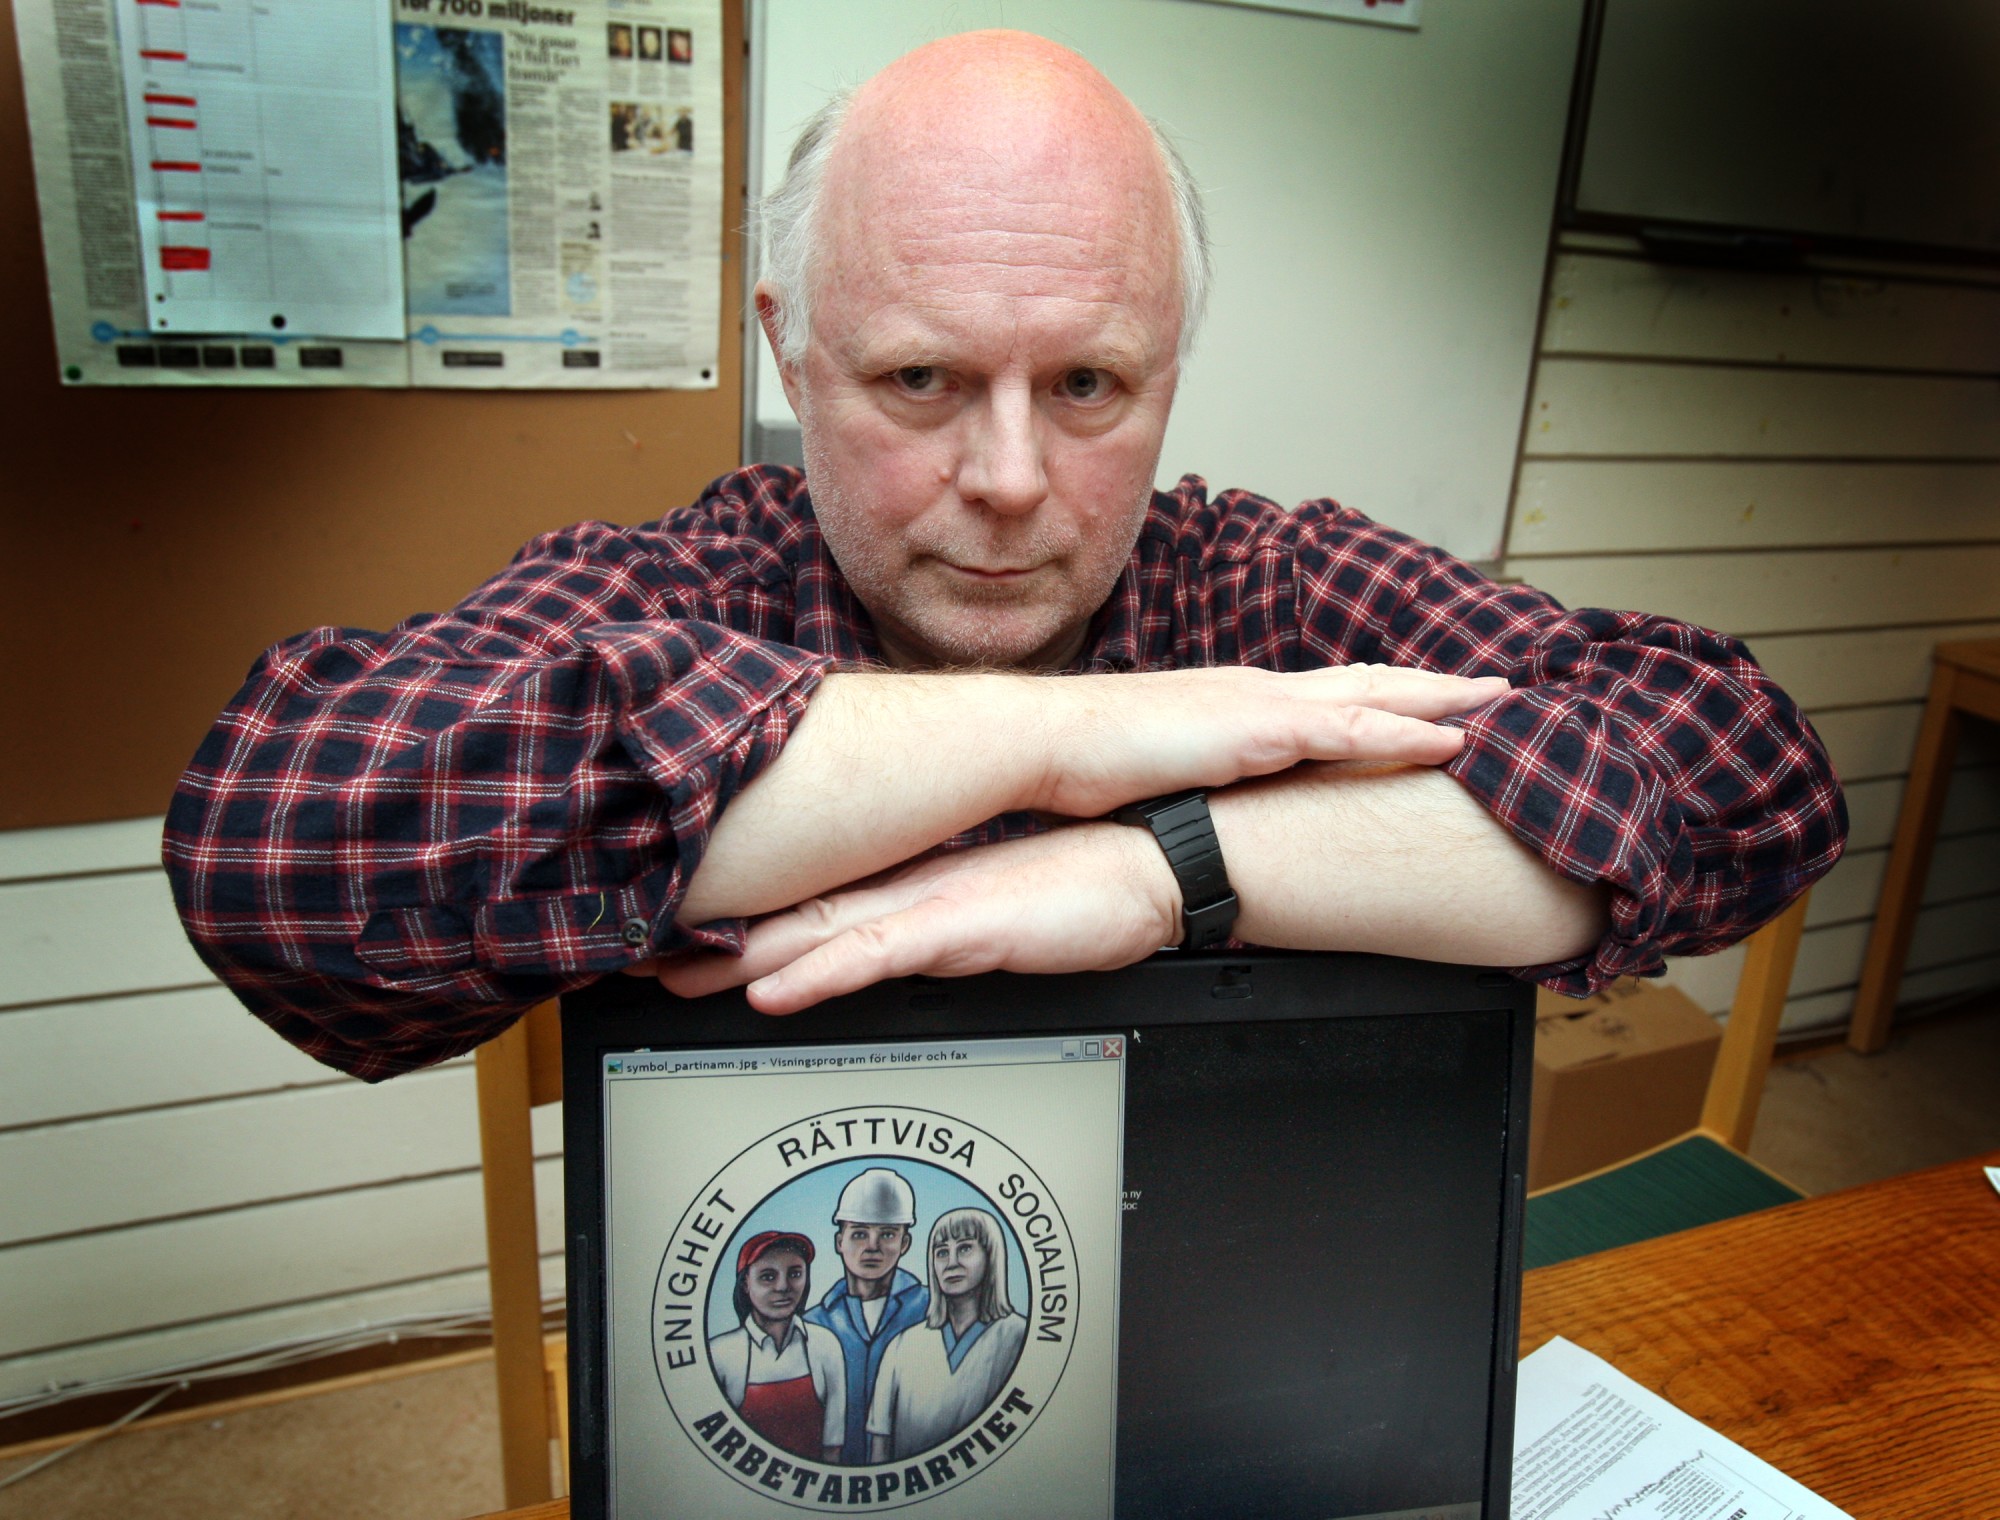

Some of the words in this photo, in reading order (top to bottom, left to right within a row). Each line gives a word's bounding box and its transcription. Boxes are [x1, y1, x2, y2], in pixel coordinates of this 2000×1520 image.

[488, 3, 575, 26] miljoner
[627, 1059, 758, 1074] symbol_partinamn.jpg
[770, 1054, 866, 1071] Visningsprogram
[869, 1053, 887, 1063] för
[890, 1051, 922, 1062] bilder
[926, 1050, 947, 1061] och
[951, 1049, 968, 1060] fax
[776, 1118, 977, 1168] RÄTTVISA
[663, 1188, 736, 1371] ENIGHET
[997, 1172, 1068, 1344] SOCIALISM
[692, 1387, 1033, 1505] ARBETARPARTIET
